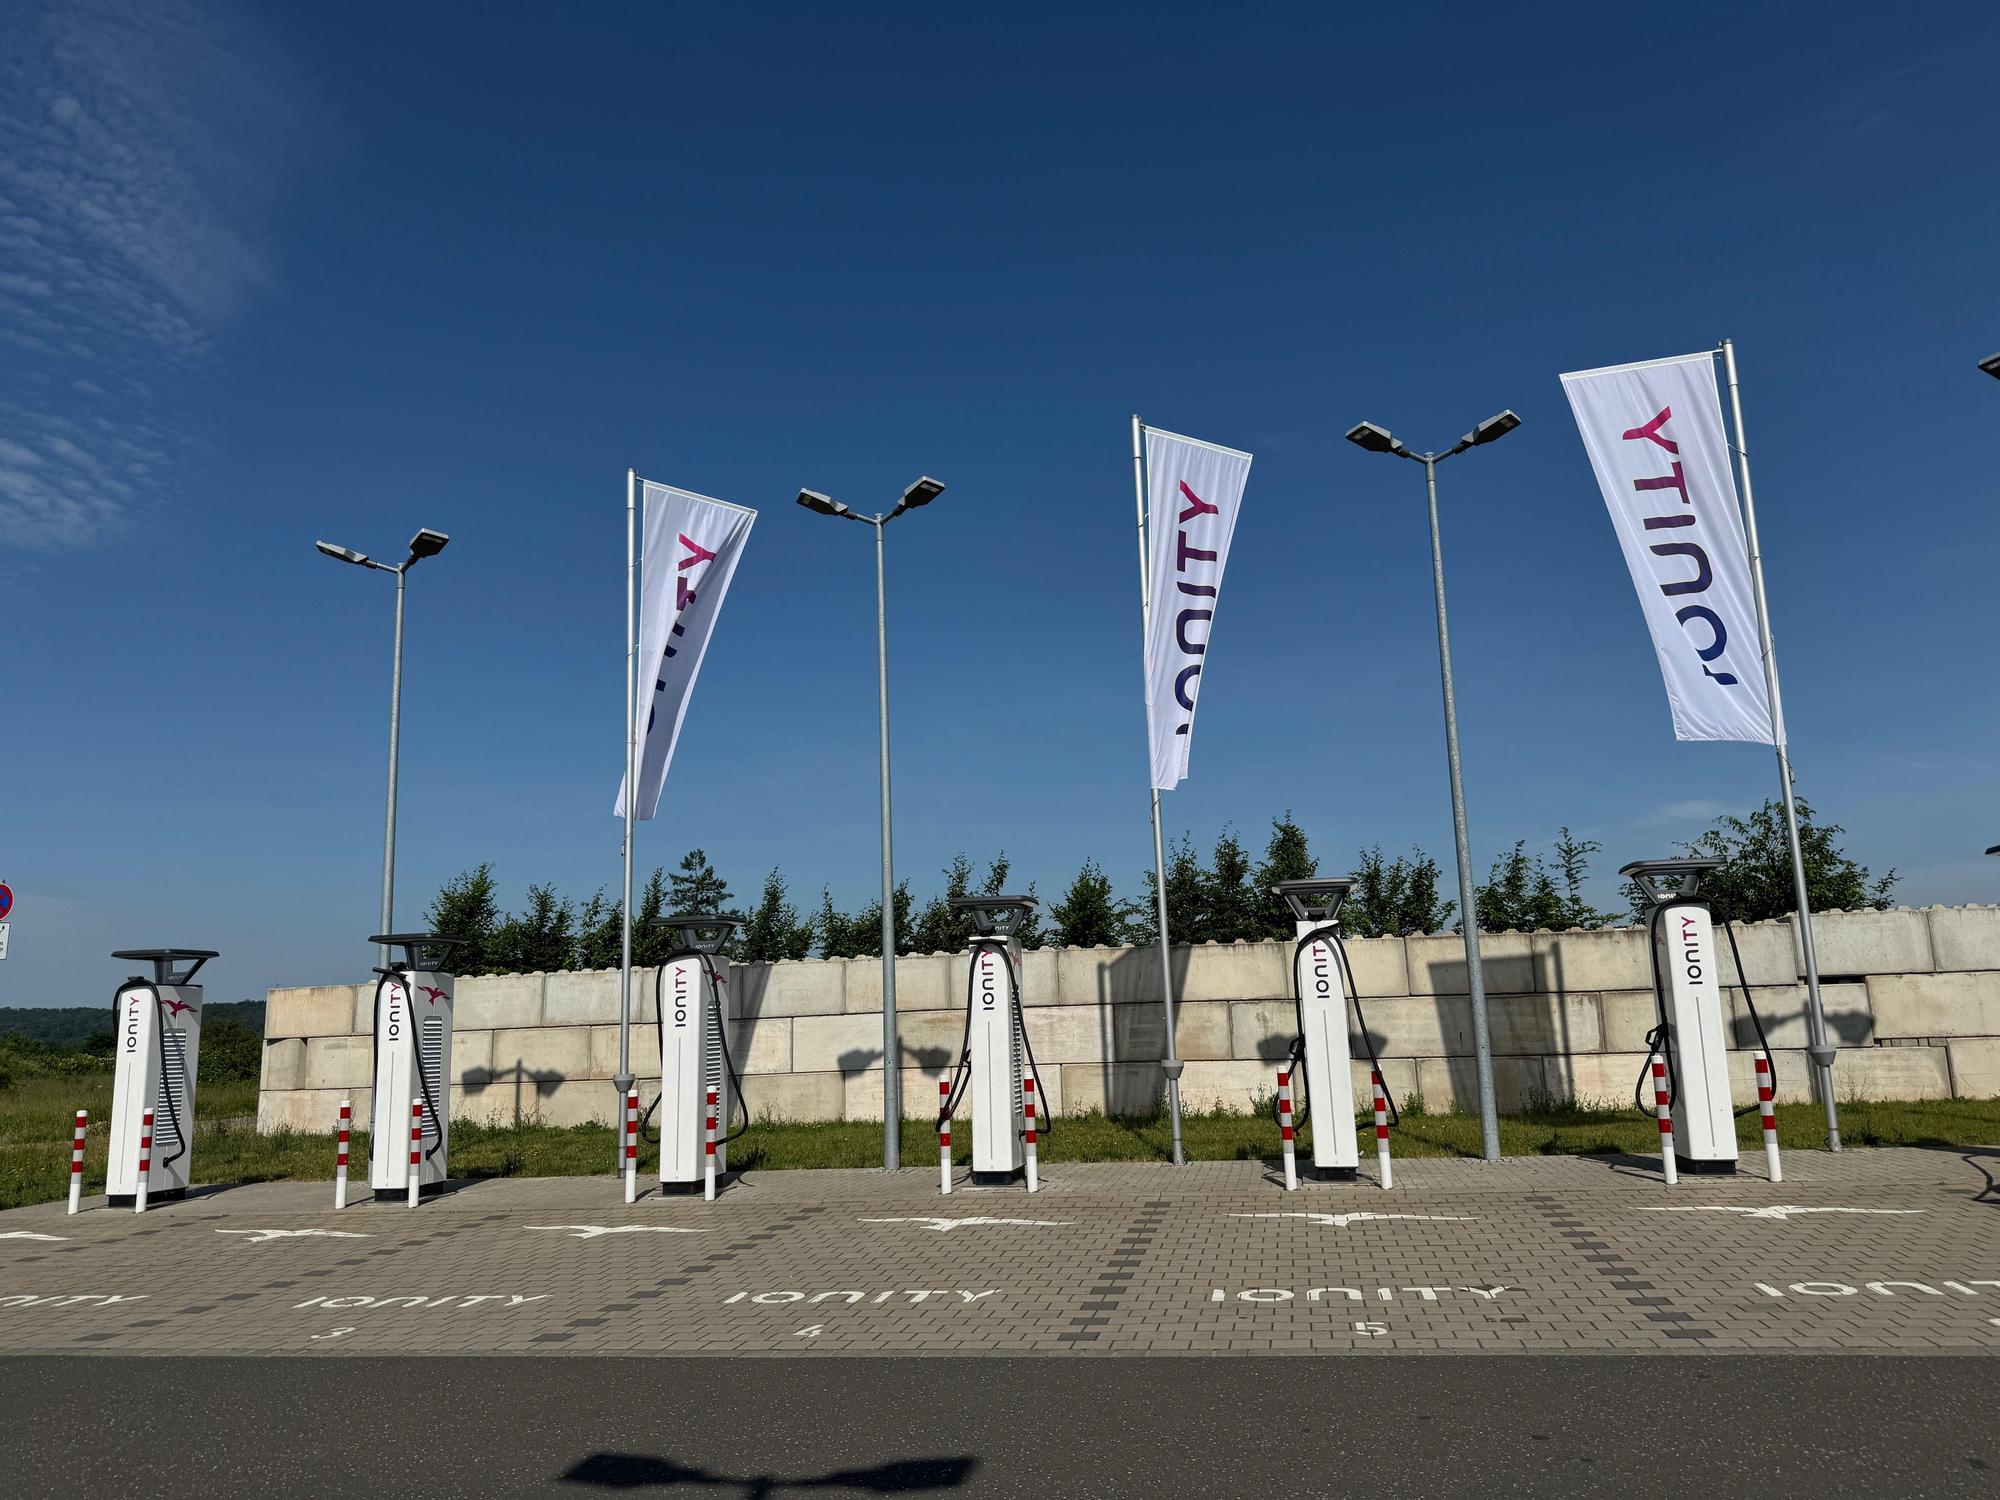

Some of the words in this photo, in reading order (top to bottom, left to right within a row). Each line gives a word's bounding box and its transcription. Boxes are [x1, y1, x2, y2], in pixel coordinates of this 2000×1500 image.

[1681, 916, 1703, 985] IONITY
[1312, 937, 1330, 999] IONITY
[981, 949, 995, 1011] IONITY
[675, 966, 687, 1028] IONITY
[389, 982, 402, 1041] IONITY
[127, 996, 140, 1053] IONITY
[0, 1295, 150, 1306] NITY
[292, 1295, 553, 1308] IONITY
[723, 1289, 1002, 1303] IONITY
[1211, 1285, 1512, 1302] IONITY
[310, 1326, 356, 1339] 3
[792, 1324, 825, 1337] 4
[1355, 1321, 1388, 1336] 5
